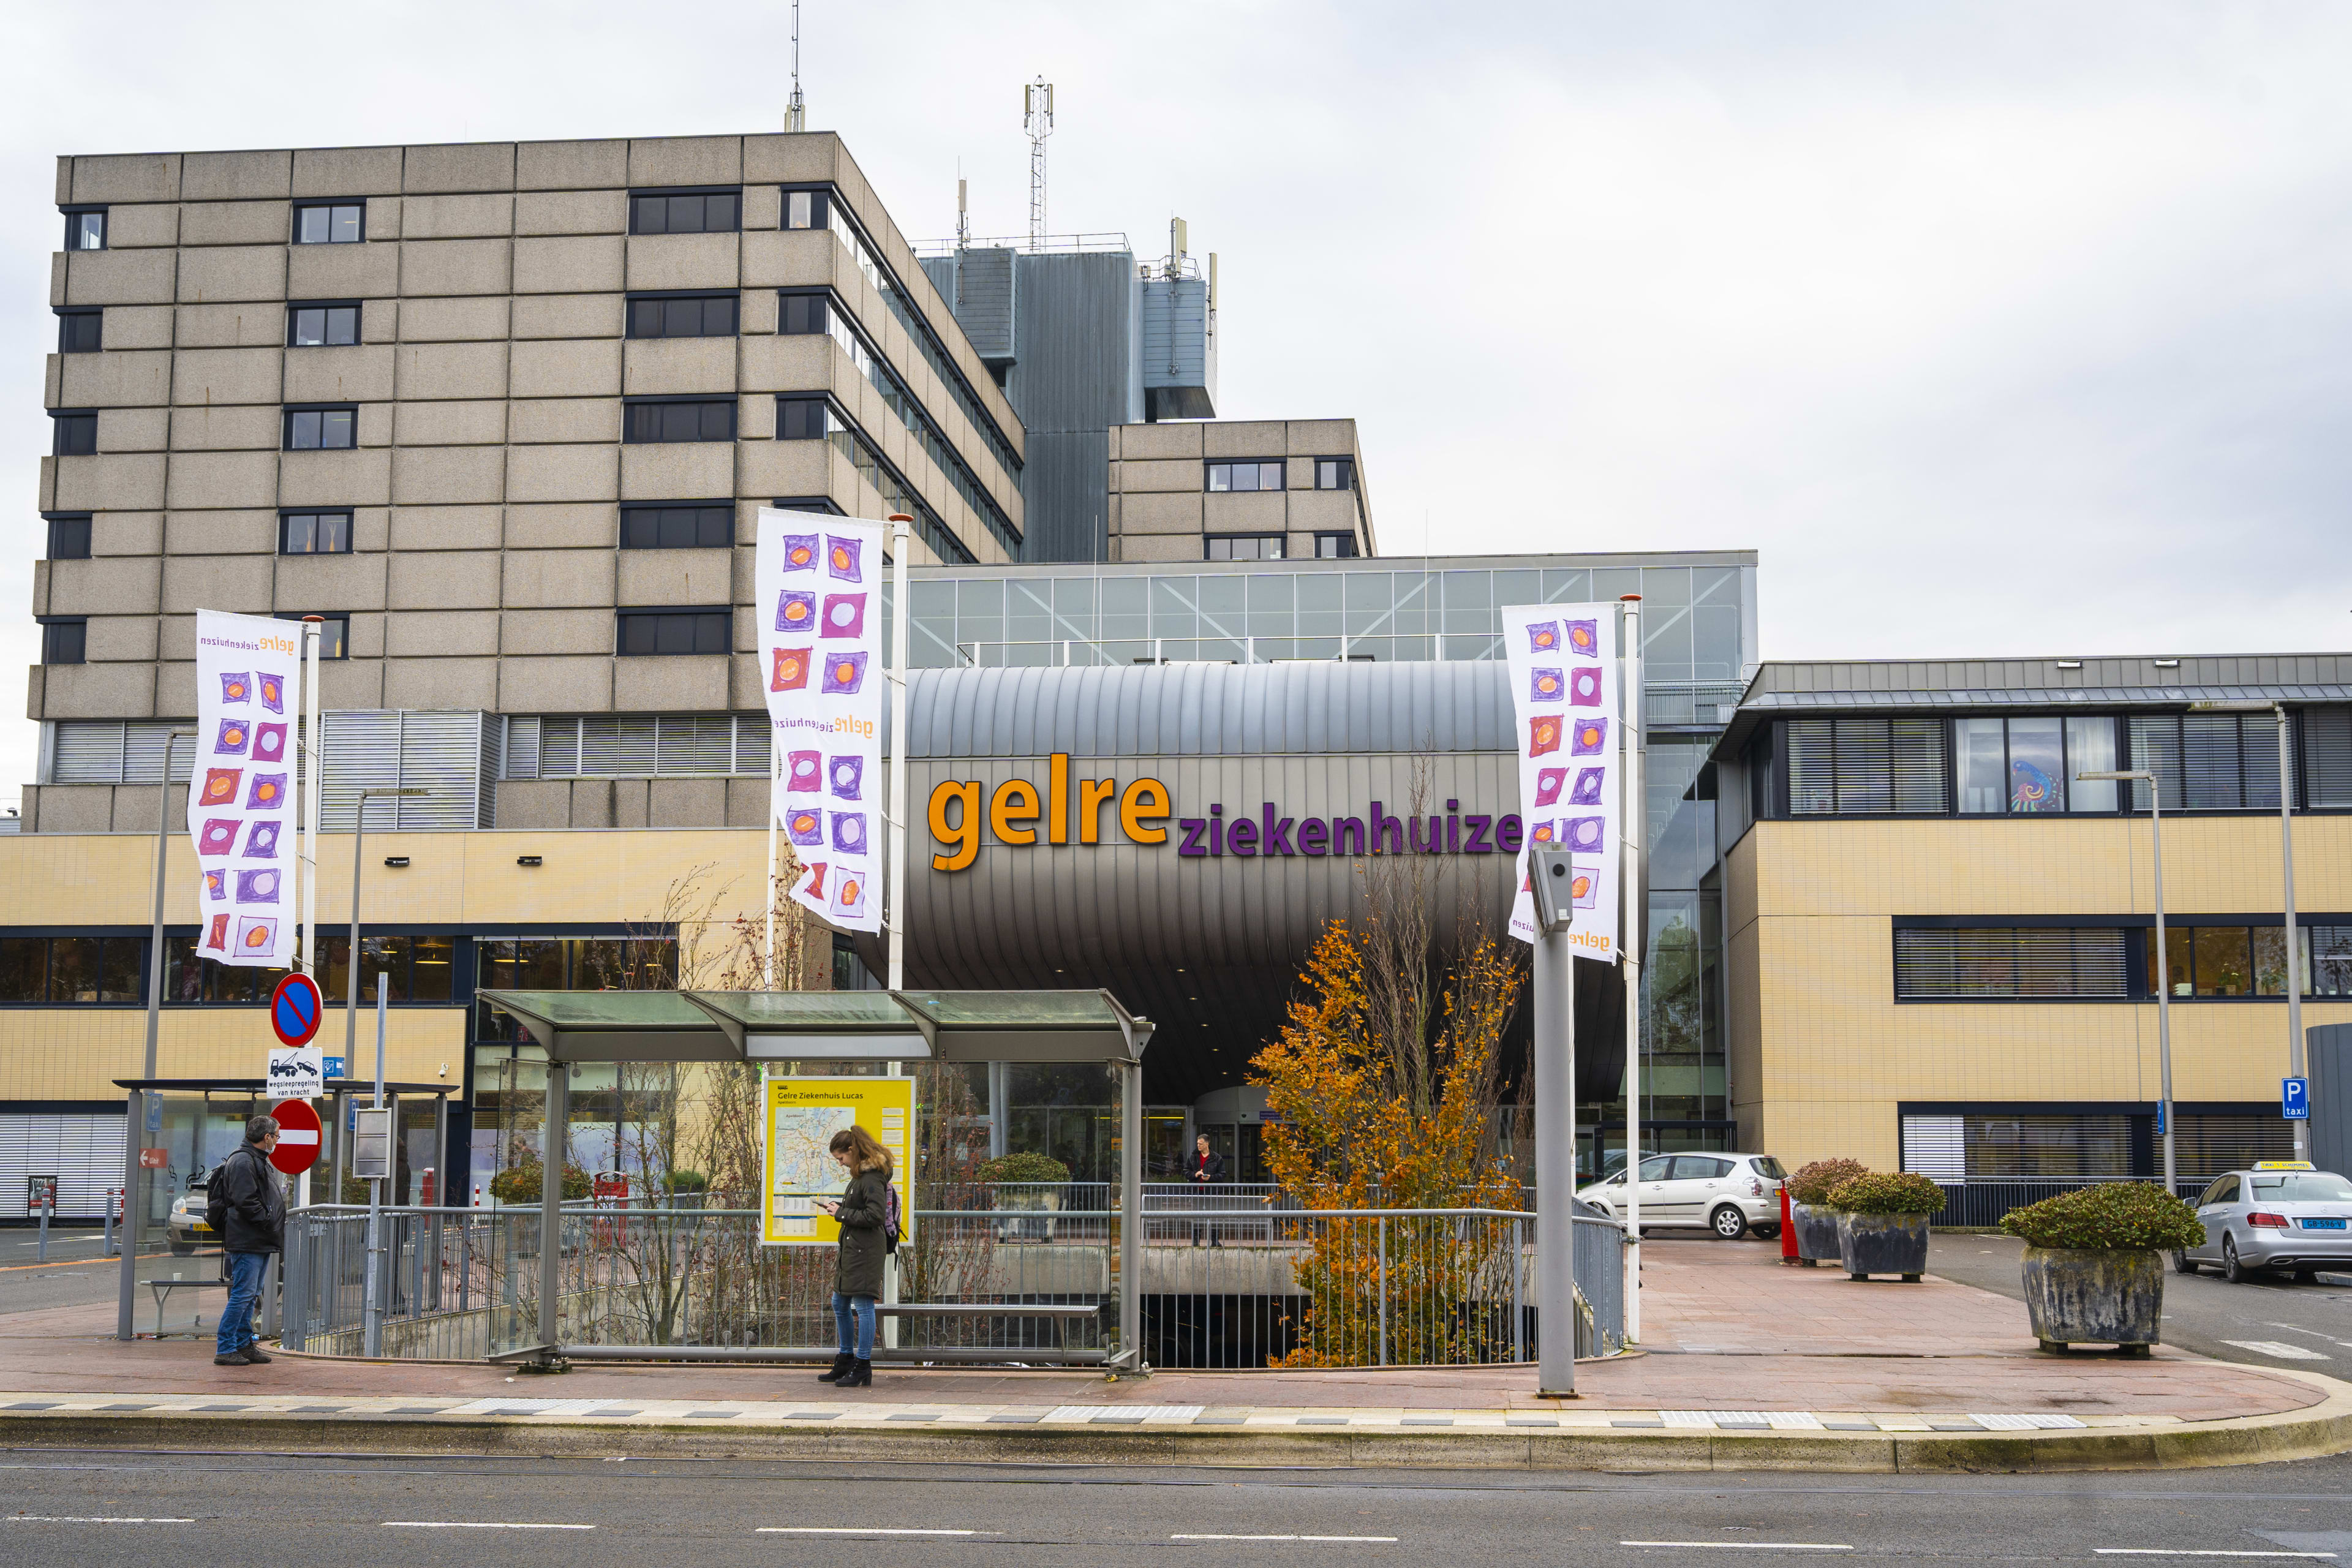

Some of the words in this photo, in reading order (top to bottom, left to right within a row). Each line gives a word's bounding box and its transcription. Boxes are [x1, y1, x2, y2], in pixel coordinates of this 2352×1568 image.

[927, 752, 1171, 872] gelre
[1178, 799, 1523, 856] ziekenhuize
[268, 1080, 319, 1088] wegsleepregeling
[2287, 1082, 2301, 1102] P
[152, 1098, 160, 1116] P
[2286, 1107, 2305, 1115] taxi
